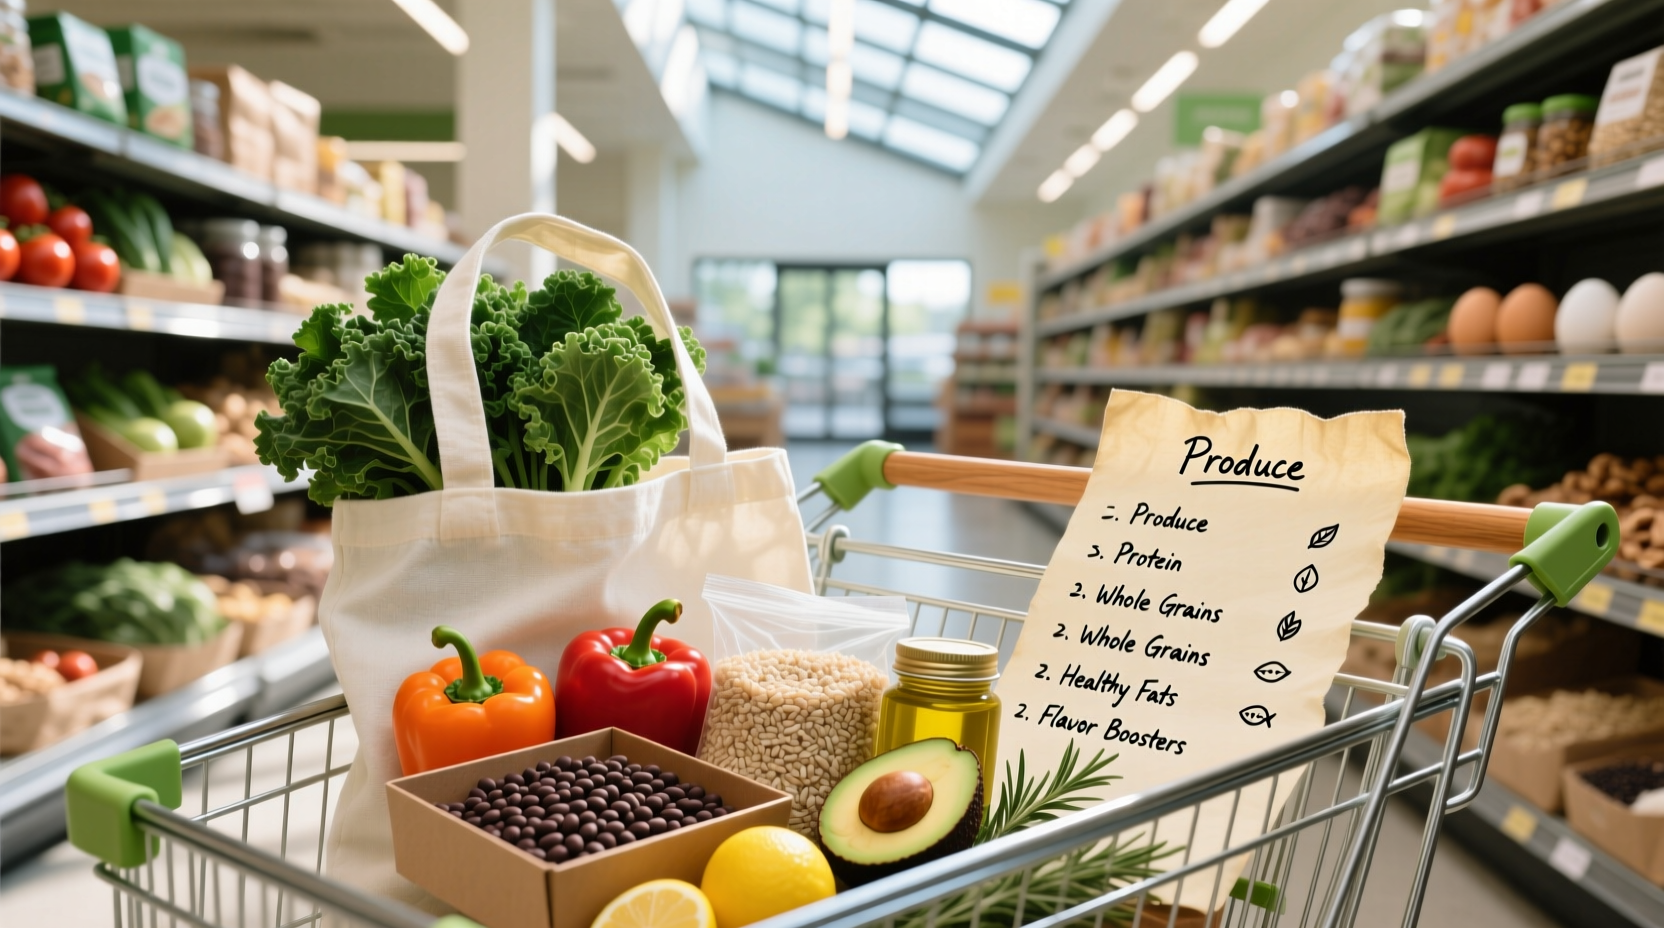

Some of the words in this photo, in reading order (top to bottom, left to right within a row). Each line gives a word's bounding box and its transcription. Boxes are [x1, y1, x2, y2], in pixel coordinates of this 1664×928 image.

[1178, 435, 1305, 481] Produce
[1129, 502, 1209, 533] Produce
[1113, 541, 1182, 572] Protein
[1069, 582, 1086, 600] 2.
[1096, 583, 1151, 612] Whole
[1158, 593, 1224, 624] Grains
[1052, 623, 1069, 641] 2.
[1080, 624, 1136, 653] Whole
[1144, 634, 1211, 667] Grains
[1034, 663, 1051, 681] 2.
[1059, 663, 1131, 708] Healthy
[1134, 679, 1179, 707] Fats
[1013, 703, 1029, 721] 2.
[1037, 704, 1099, 736] Flavor
[1103, 718, 1187, 755] Boosters
